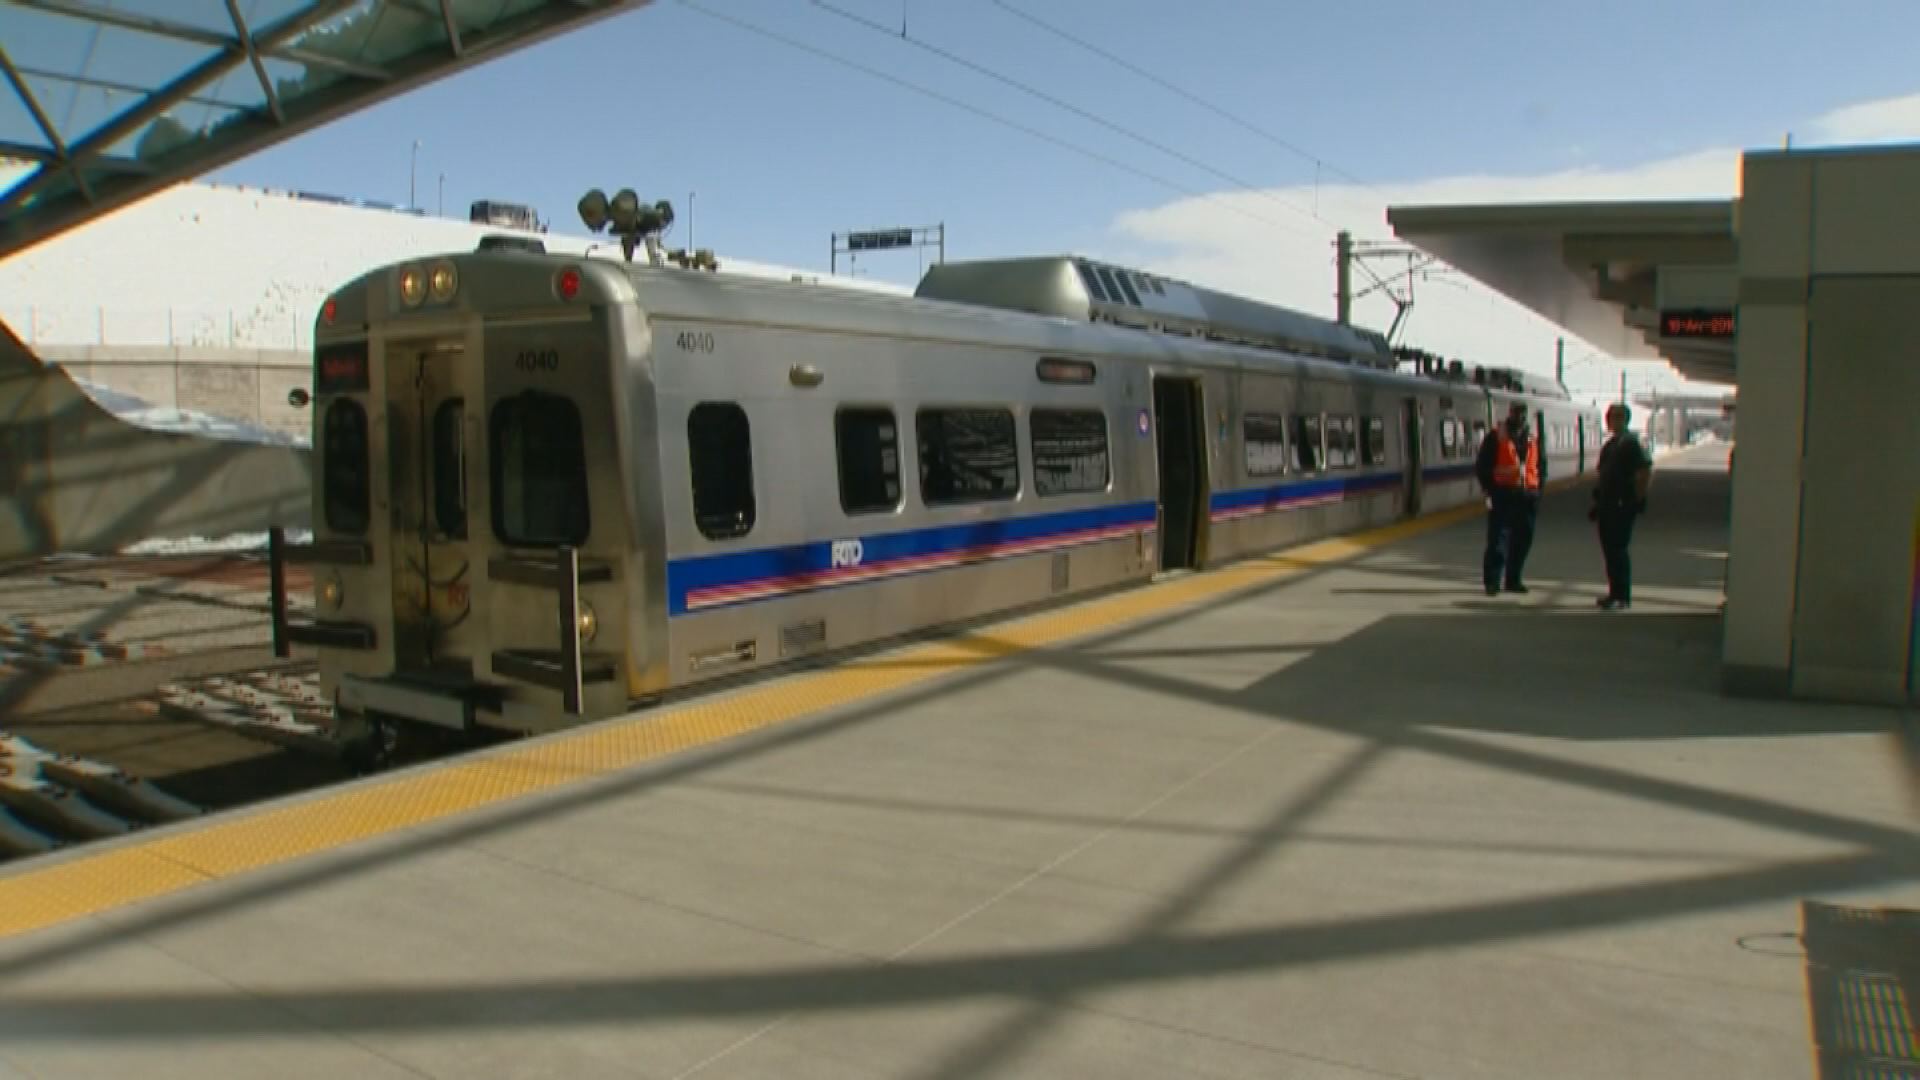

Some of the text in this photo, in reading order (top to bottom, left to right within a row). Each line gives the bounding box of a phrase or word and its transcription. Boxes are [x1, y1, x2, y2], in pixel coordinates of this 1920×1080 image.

[676, 332, 714, 353] 4040
[515, 351, 559, 371] 4040
[831, 540, 864, 567] RTD
